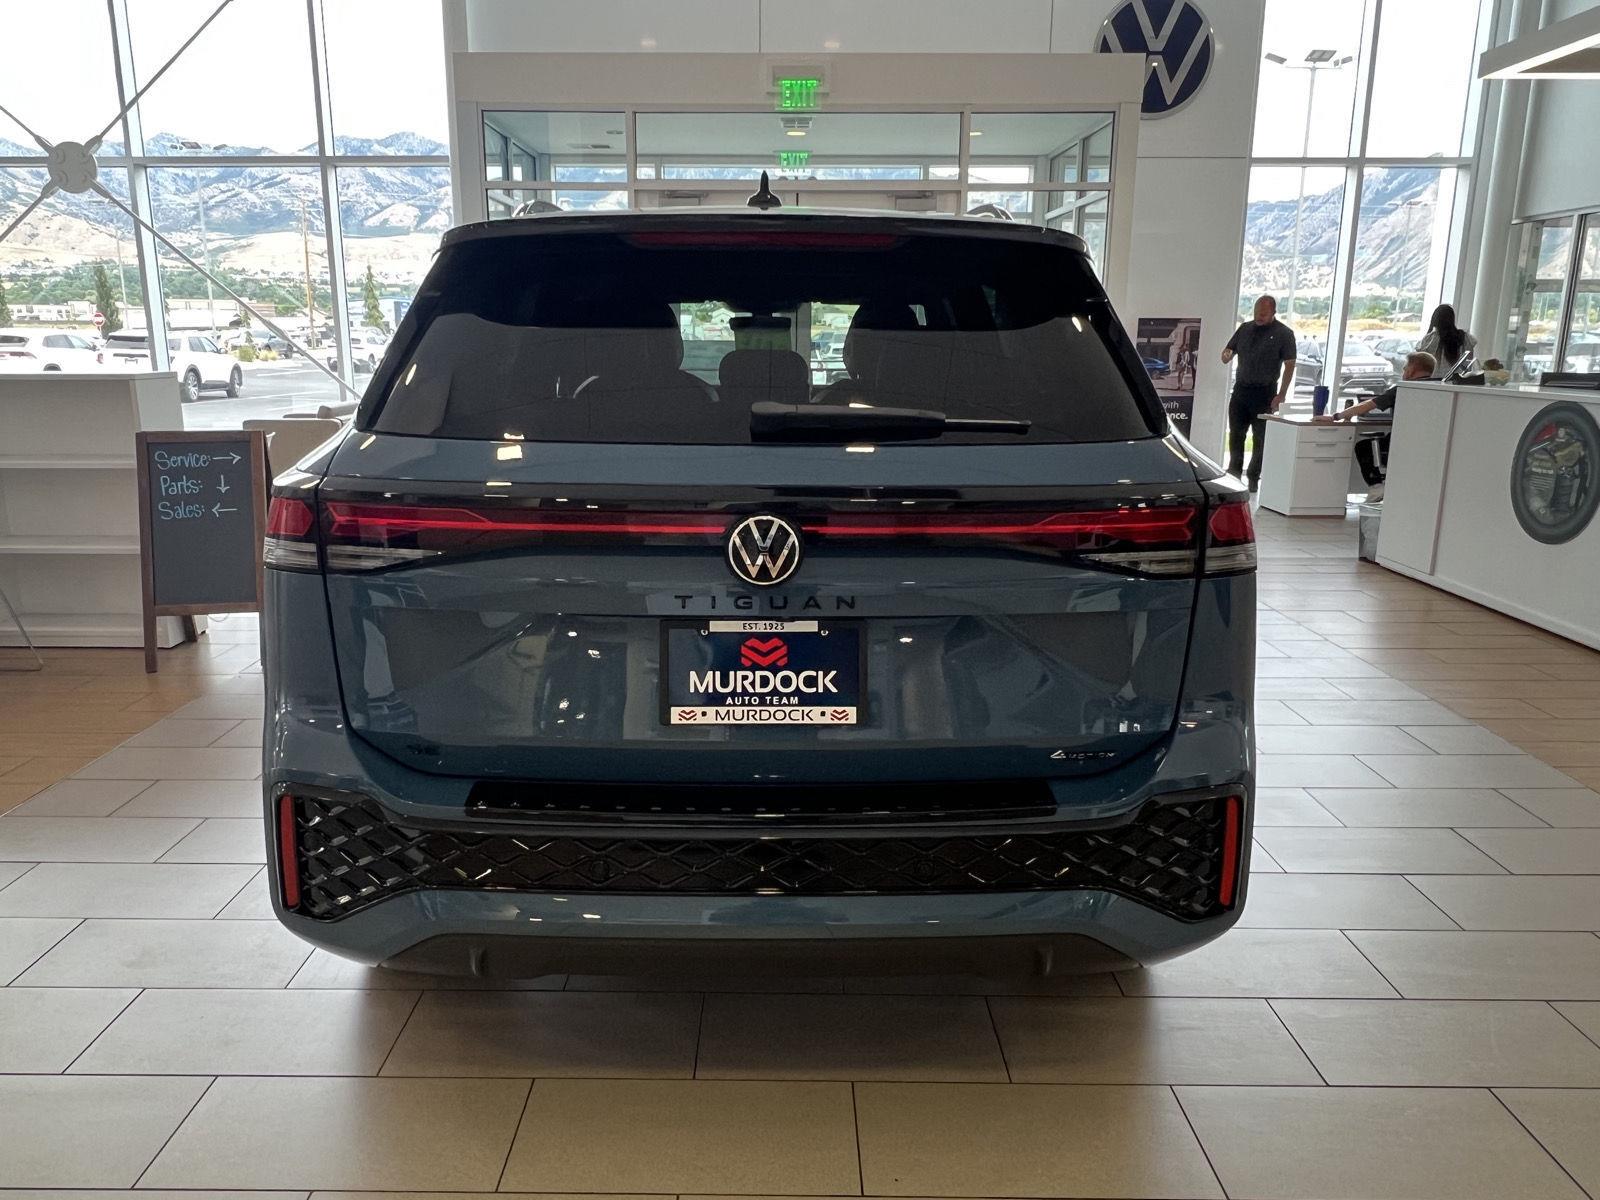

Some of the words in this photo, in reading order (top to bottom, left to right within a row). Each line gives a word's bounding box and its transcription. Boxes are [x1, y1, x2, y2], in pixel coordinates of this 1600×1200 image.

[782, 80, 817, 107] EXIT
[780, 152, 808, 171] EXIT
[154, 450, 212, 470] Service:
[160, 475, 203, 497] Parts:
[158, 501, 205, 520] Sales:
[674, 595, 856, 610] TIGUAN
[742, 622, 761, 631] EST.
[763, 622, 785, 631] 1925
[689, 670, 839, 694] MURDOCK
[725, 696, 759, 705] AUTO
[765, 696, 799, 705] TEAM
[715, 709, 814, 722] MURDOCK
